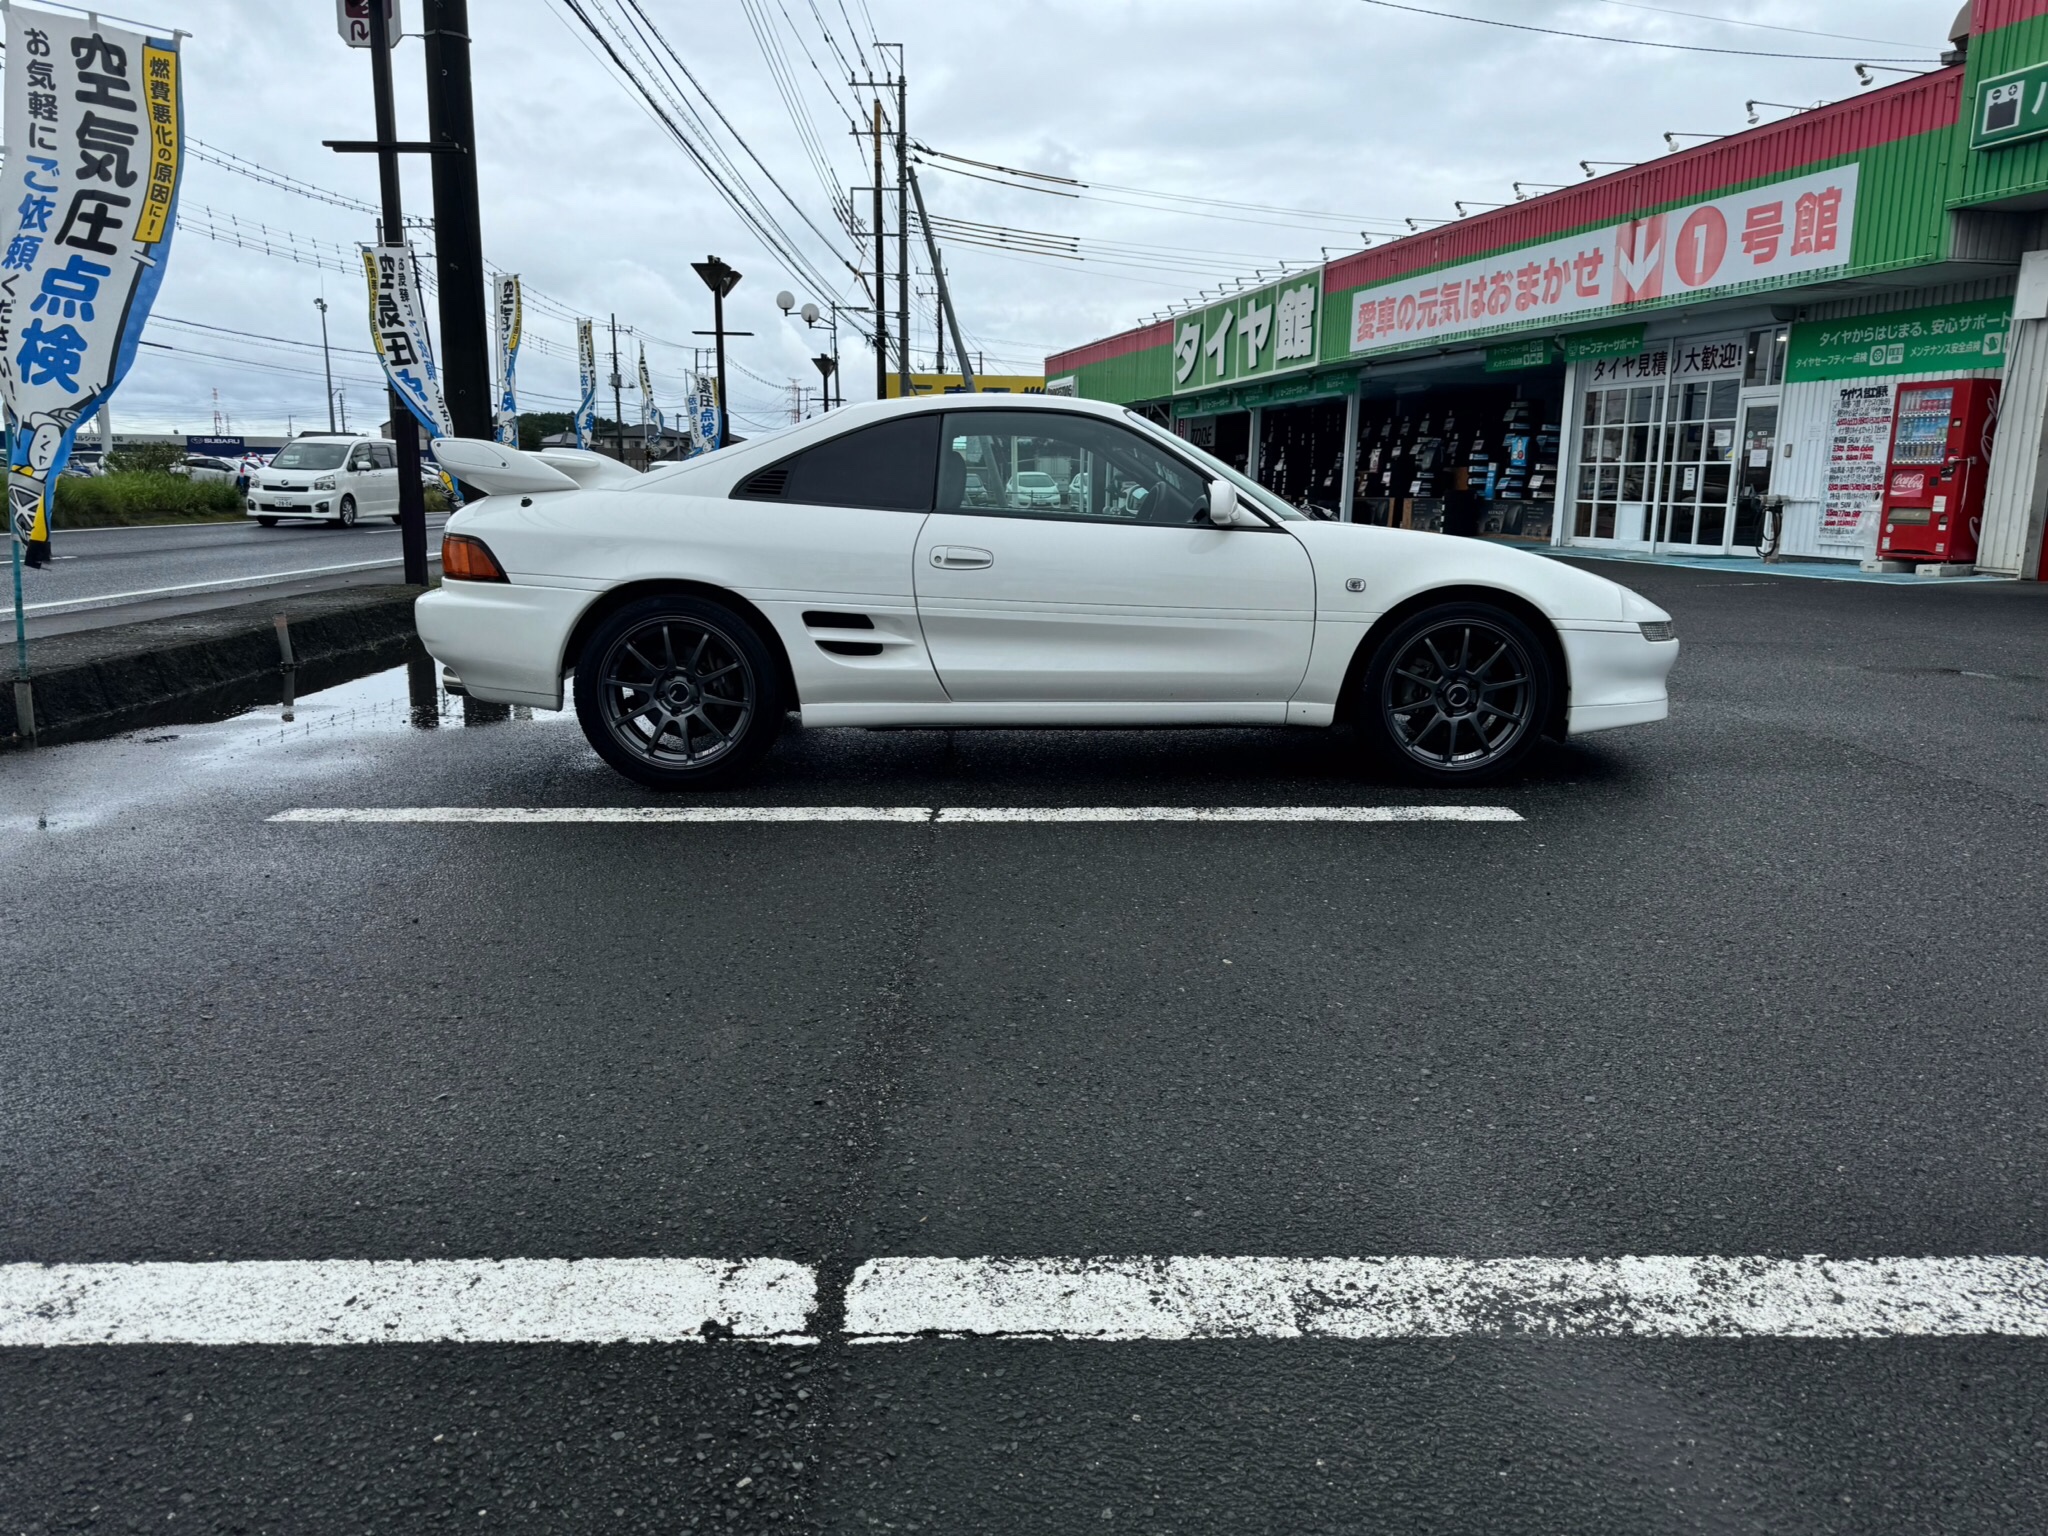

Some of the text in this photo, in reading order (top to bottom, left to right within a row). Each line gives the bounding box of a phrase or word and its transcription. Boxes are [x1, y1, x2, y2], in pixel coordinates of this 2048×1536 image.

[147, 57, 174, 236] 燃費悪化の原因に!
[17, 33, 139, 393] 空気圧点検
[1358, 247, 1604, 341] 愛車の元気はおまかせ
[1174, 283, 1316, 384] タイヤ館
[1579, 337, 1639, 355] セーフティーサポート
[1819, 312, 2011, 347] タイヤからはじまる、安心サポート
[1795, 352, 1868, 368] タイヤセーフティー点検
[1910, 341, 1981, 358] メンテナンス安全点検
[203, 437, 240, 445] SUBARU
